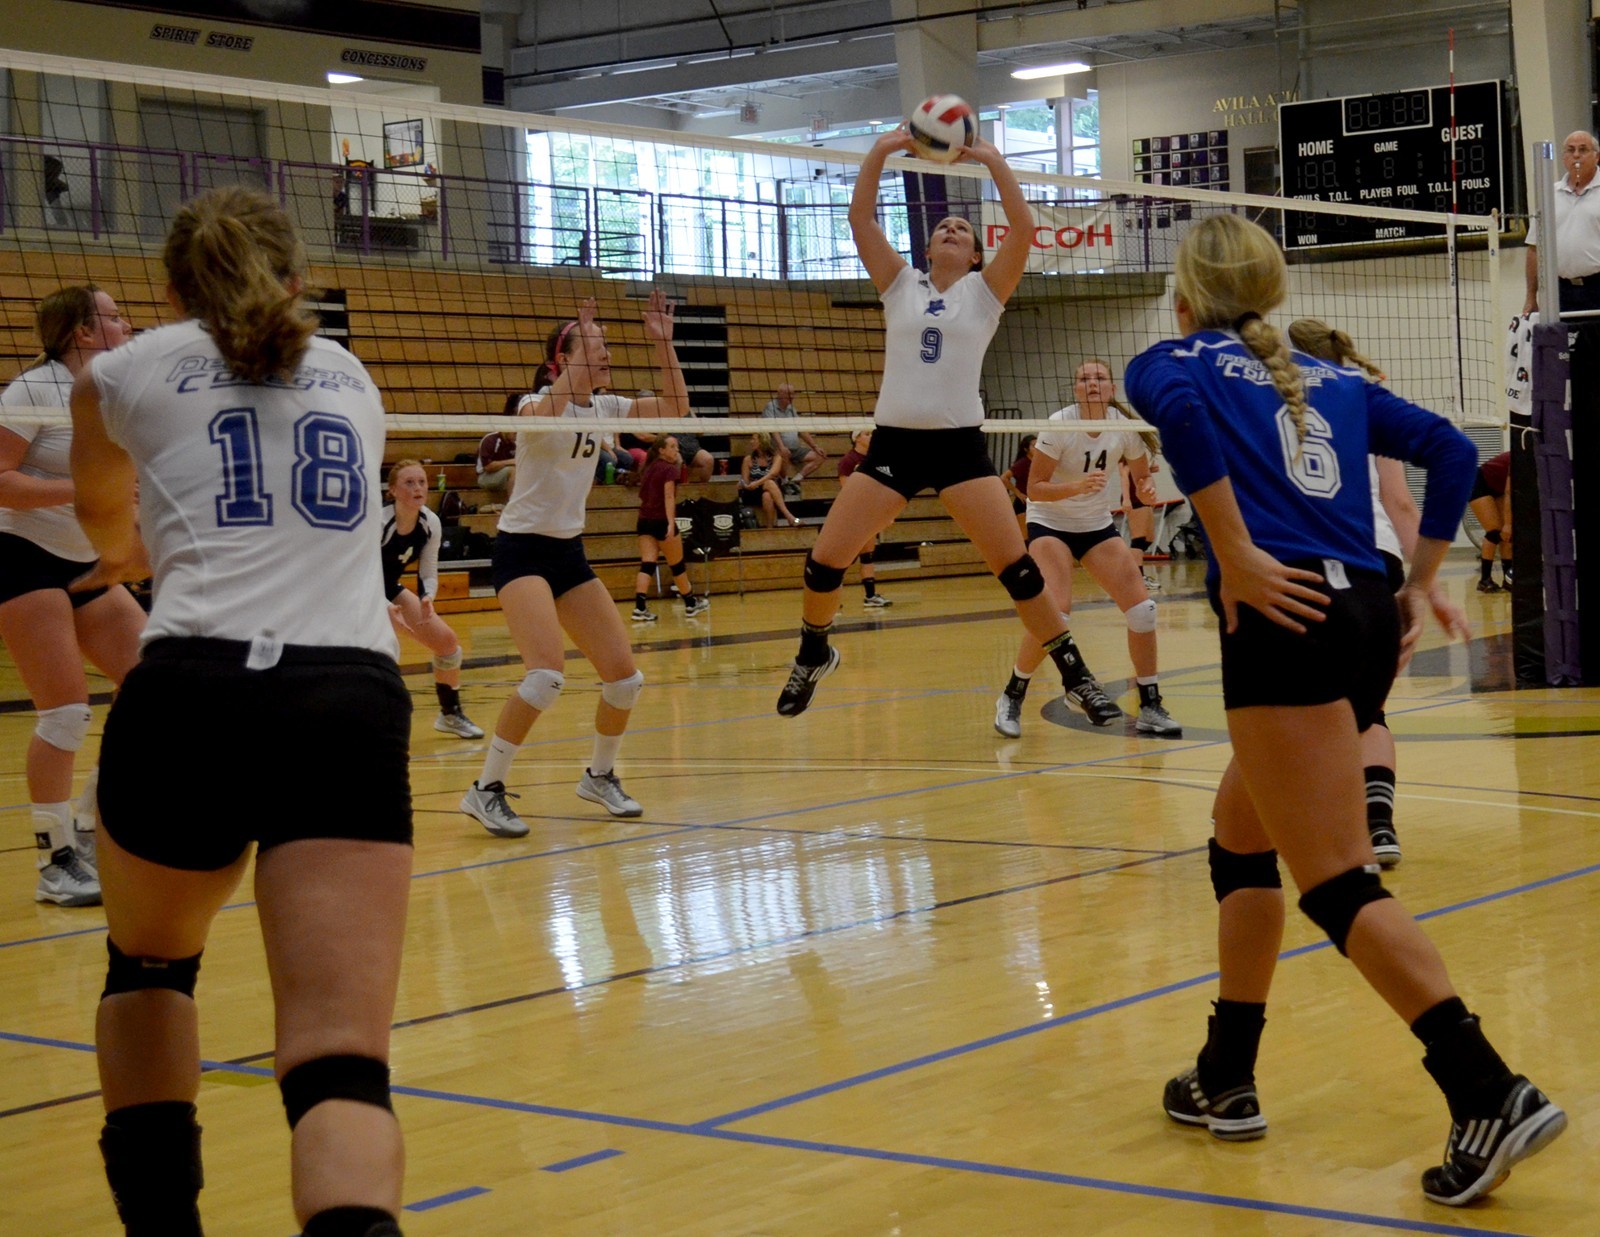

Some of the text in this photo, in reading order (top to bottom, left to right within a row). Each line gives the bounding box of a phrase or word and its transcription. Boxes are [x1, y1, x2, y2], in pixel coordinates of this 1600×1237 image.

[151, 26, 252, 50] SPIRIT STORE
[341, 50, 427, 71] CONCESSIONS
[1212, 95, 1261, 113] AVILA
[1441, 124, 1484, 142] GUEST
[1298, 140, 1334, 156] HOME
[1374, 141, 1398, 153] GAME
[1360, 186, 1393, 199] PLAYER
[1397, 184, 1419, 196] FOUL
[1461, 177, 1491, 190] FOULS
[987, 223, 1113, 249] RCOH
[1297, 234, 1318, 245] WON
[1375, 226, 1406, 239] MATCH
[920, 327, 943, 364] 9
[571, 431, 596, 459] 15
[1275, 403, 1342, 499] 6
[208, 407, 368, 531] 18
[1083, 449, 1107, 473] 14
